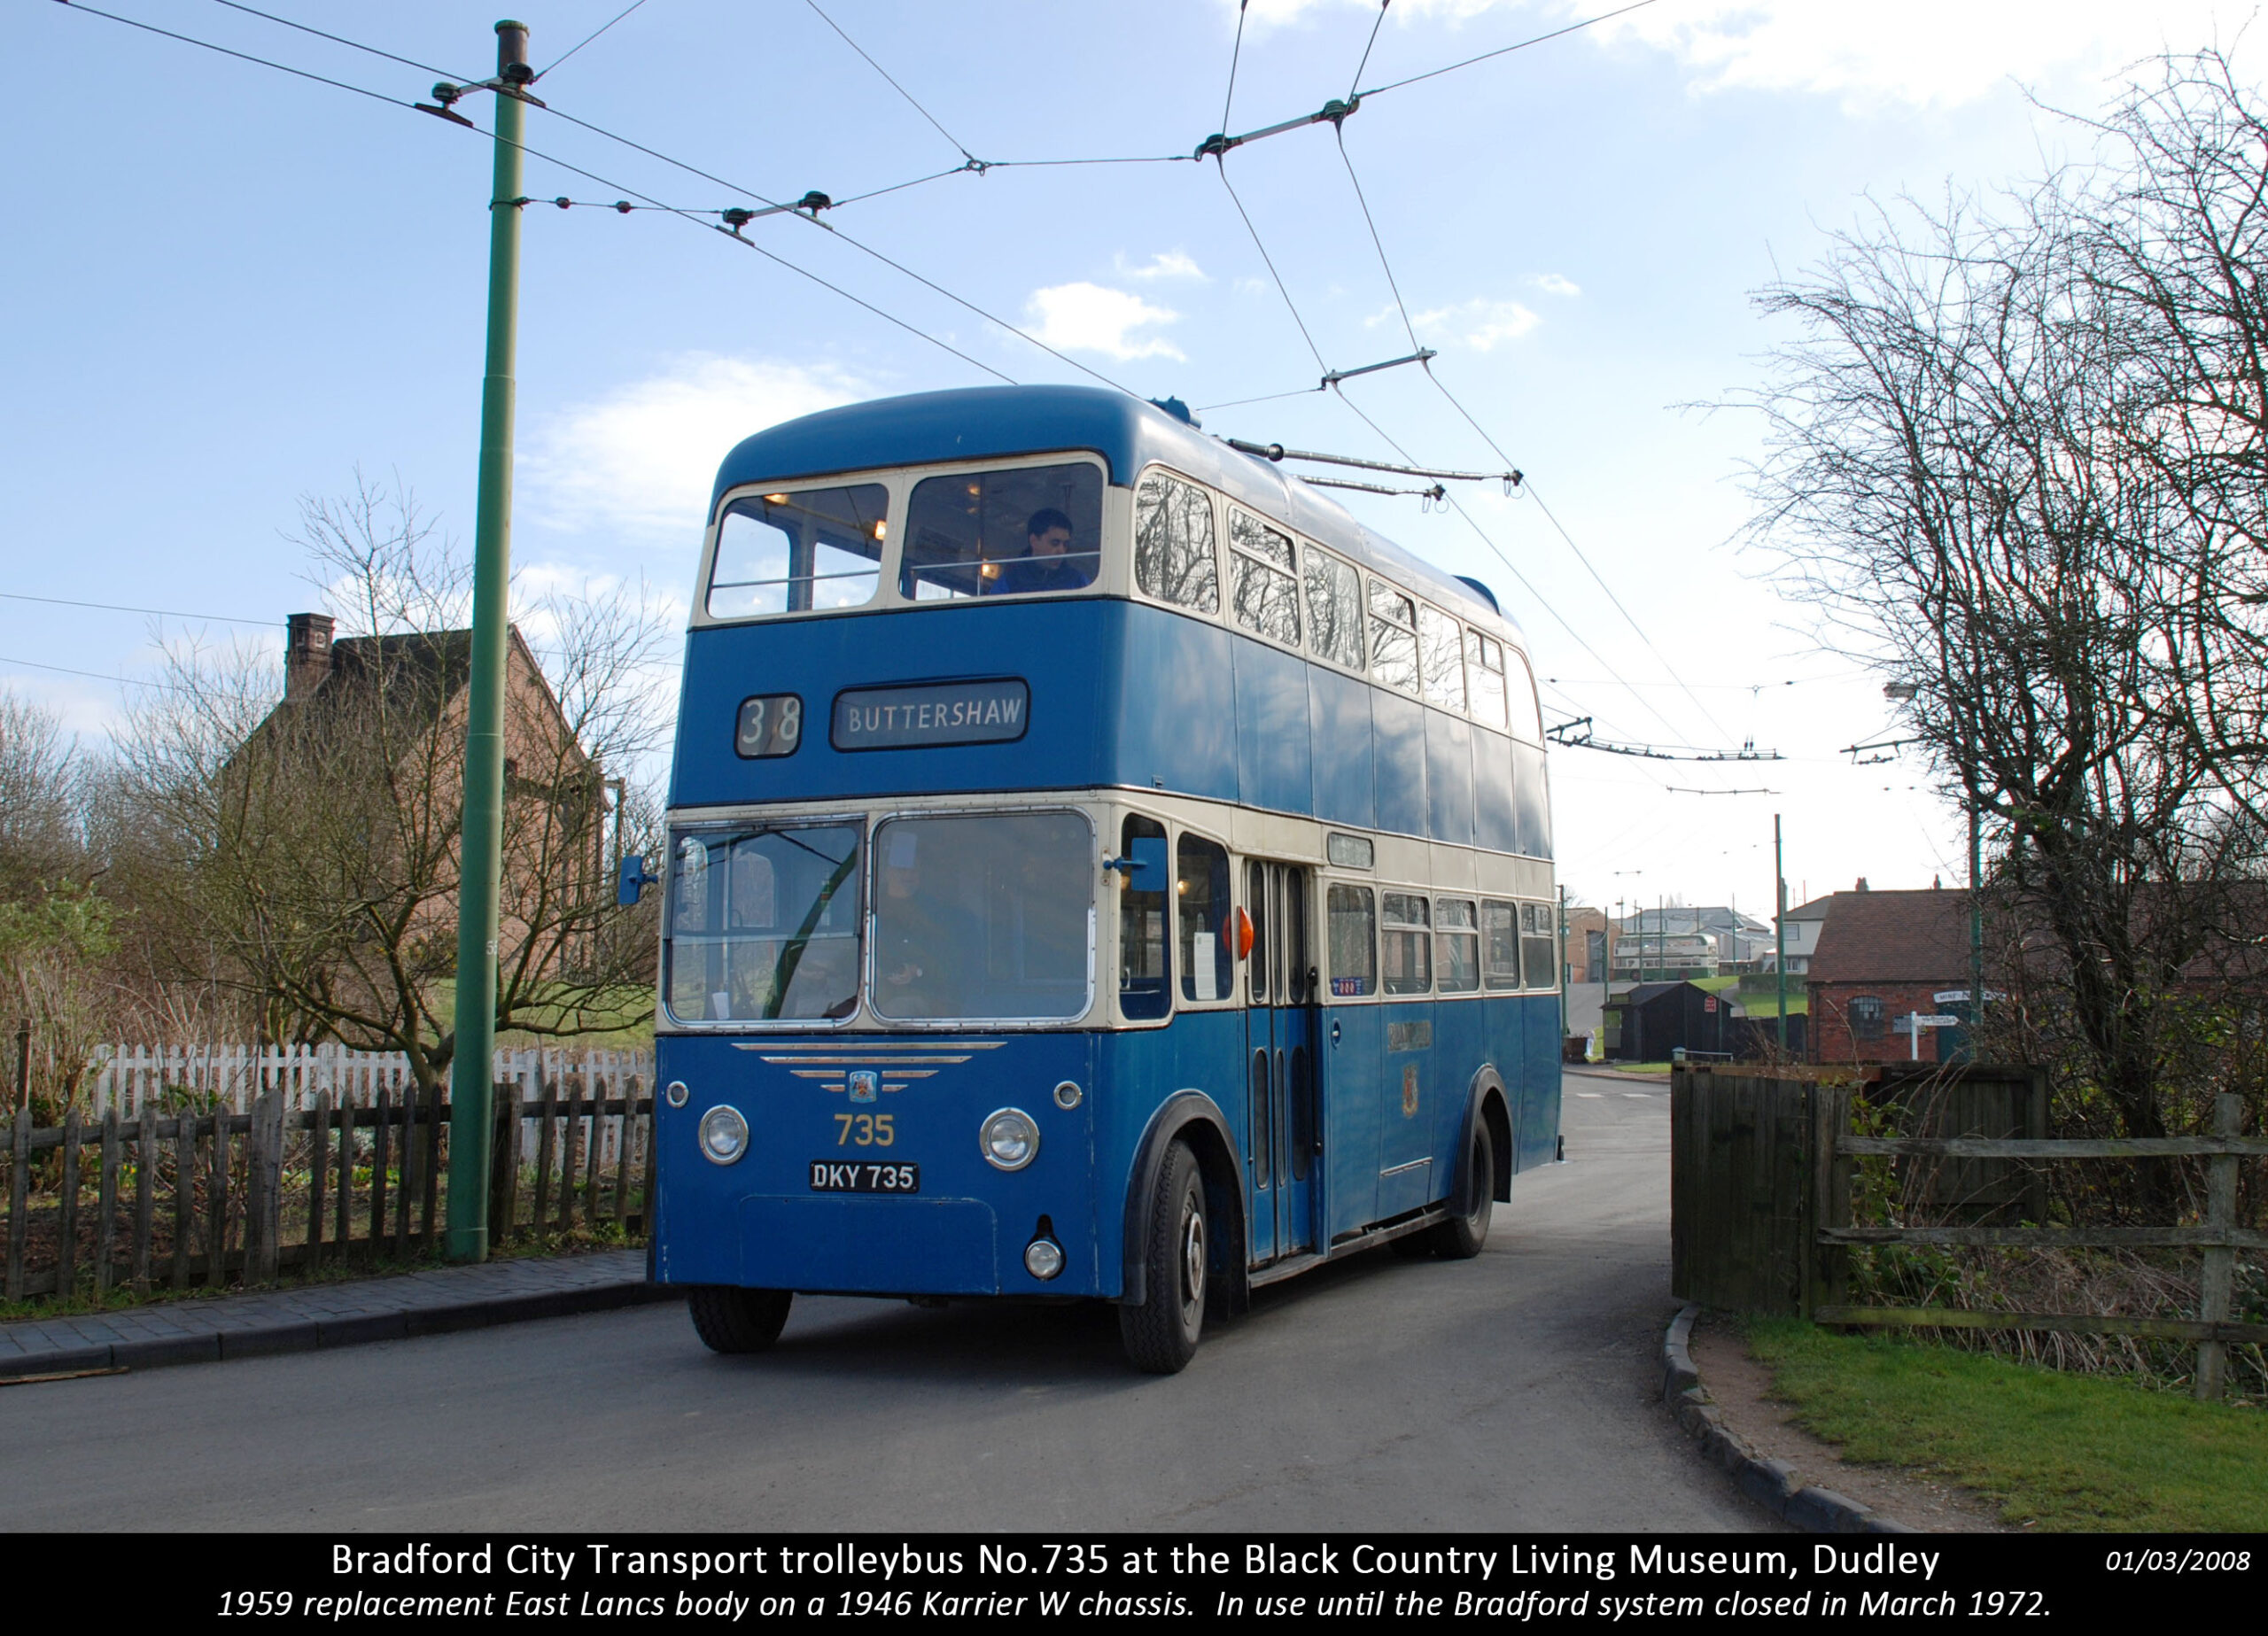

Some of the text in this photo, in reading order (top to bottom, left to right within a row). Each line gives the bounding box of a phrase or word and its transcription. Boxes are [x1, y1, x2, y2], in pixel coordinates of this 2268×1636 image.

[742, 697, 800, 743] 38
[849, 698, 1021, 733] BUTTERSHAW
[835, 1113, 895, 1146] 735
[813, 1164, 914, 1189] DKY 735
